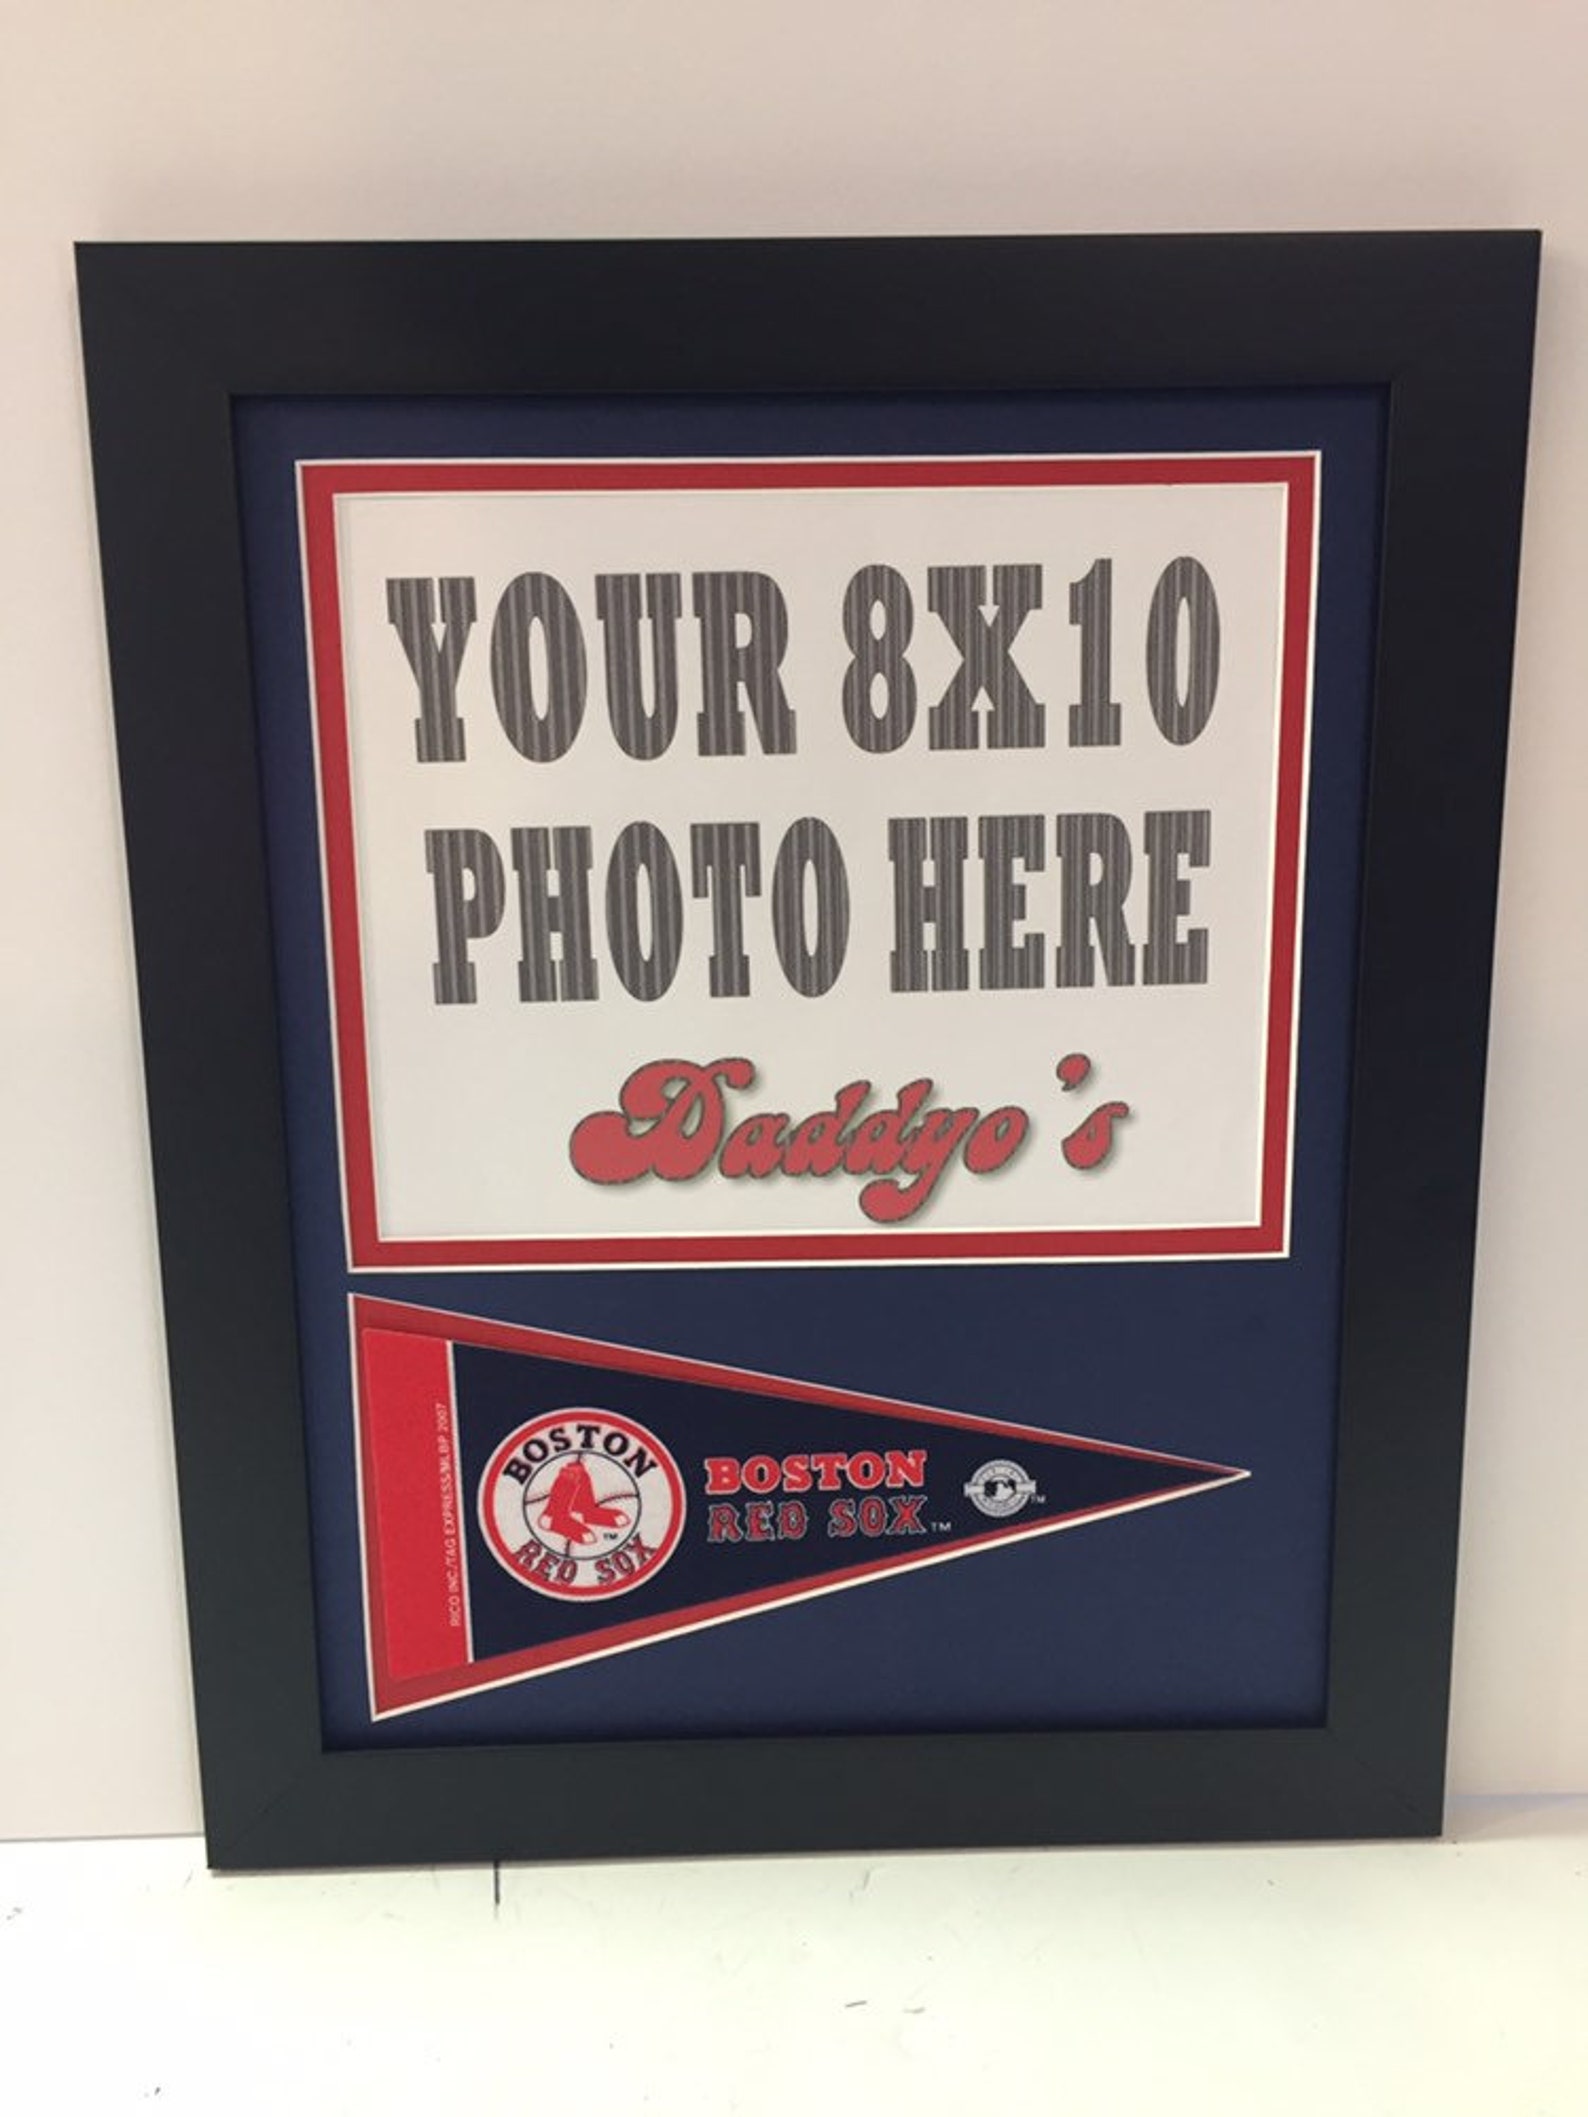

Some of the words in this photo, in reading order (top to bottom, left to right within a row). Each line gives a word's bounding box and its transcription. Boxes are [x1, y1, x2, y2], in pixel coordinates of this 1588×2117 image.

[385, 571, 796, 762] YOUR
[841, 556, 1220, 754] 8X10
[424, 817, 850, 1004] PHOTO
[887, 810, 1211, 992] HERE
[569, 1053, 1130, 1223] Daddyo's
[436, 1403, 450, 1432] 2007
[503, 1425, 658, 1485] BOSTON
[705, 1450, 927, 1495] BOSTON
[707, 1501, 808, 1542] RED
[828, 1496, 928, 1537] SOX
[512, 1538, 578, 1585] RED
[595, 1532, 656, 1583] SOX
[448, 1596, 461, 1627] RICO
